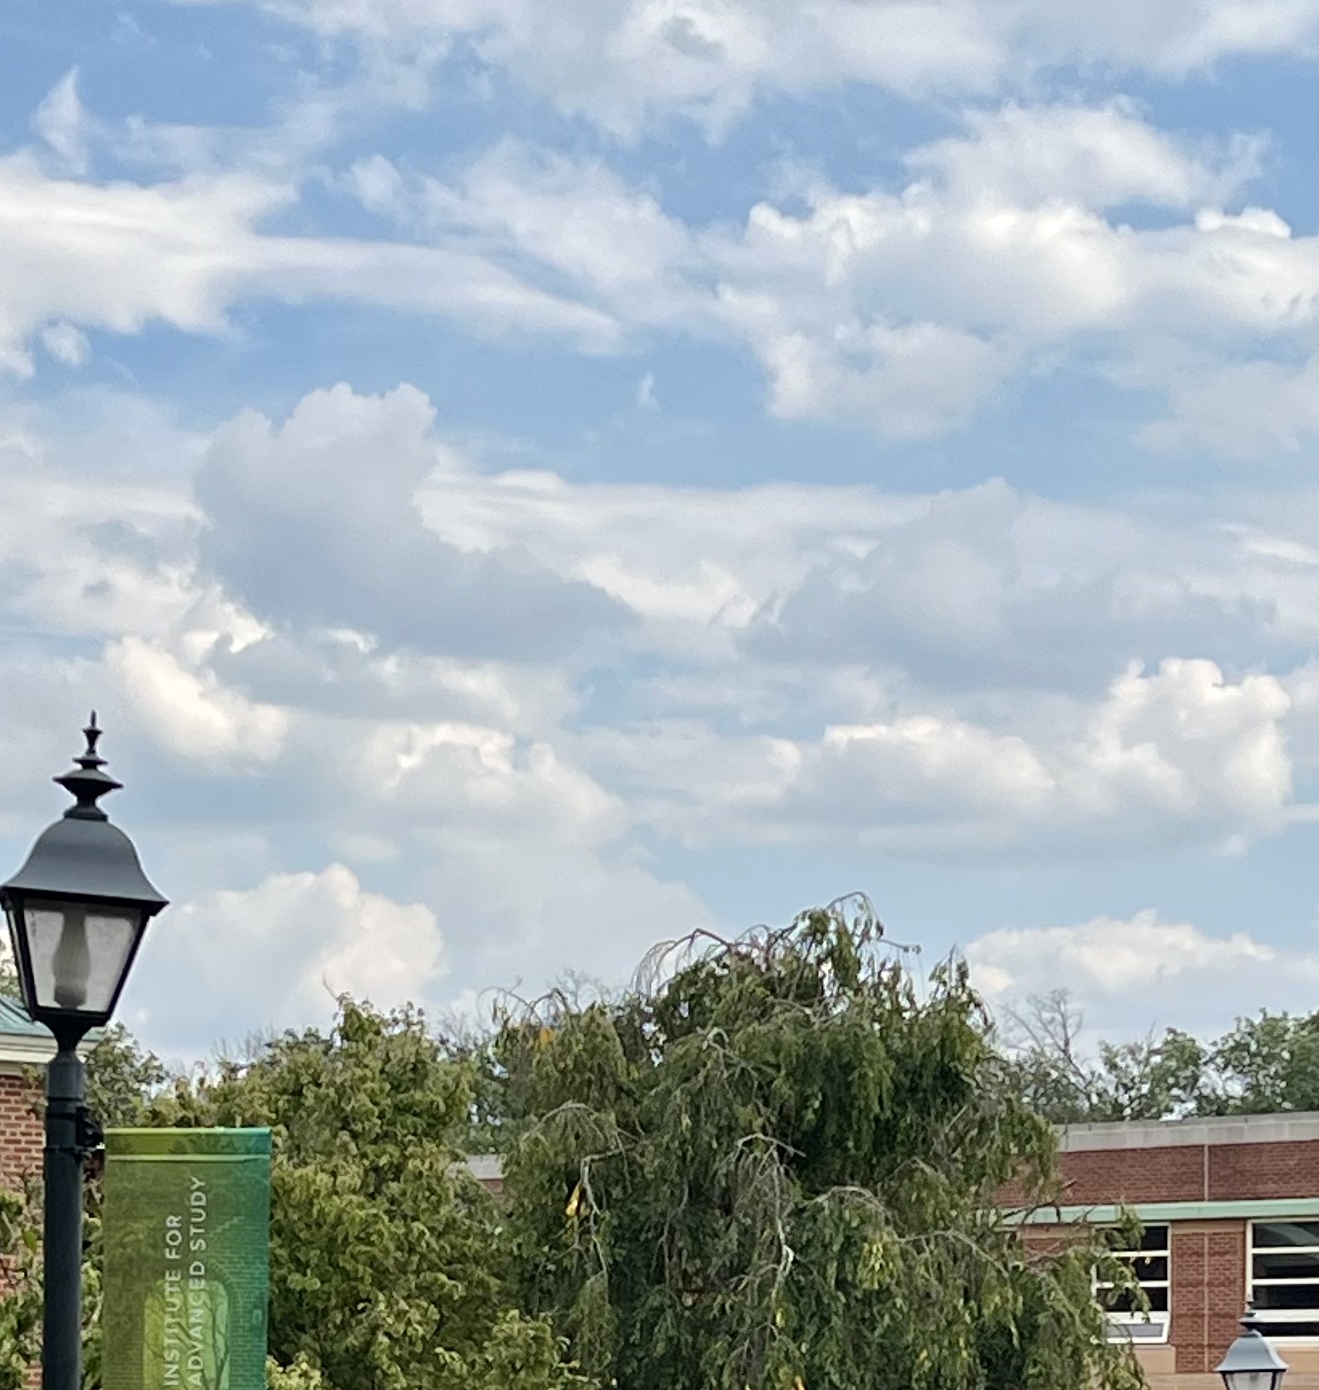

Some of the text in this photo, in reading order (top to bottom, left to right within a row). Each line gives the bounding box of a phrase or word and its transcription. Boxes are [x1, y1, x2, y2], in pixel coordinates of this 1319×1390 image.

[164, 1215, 183, 1387] INSTITUTE FOR
[188, 1176, 207, 1387] ADVANCED STUDY
